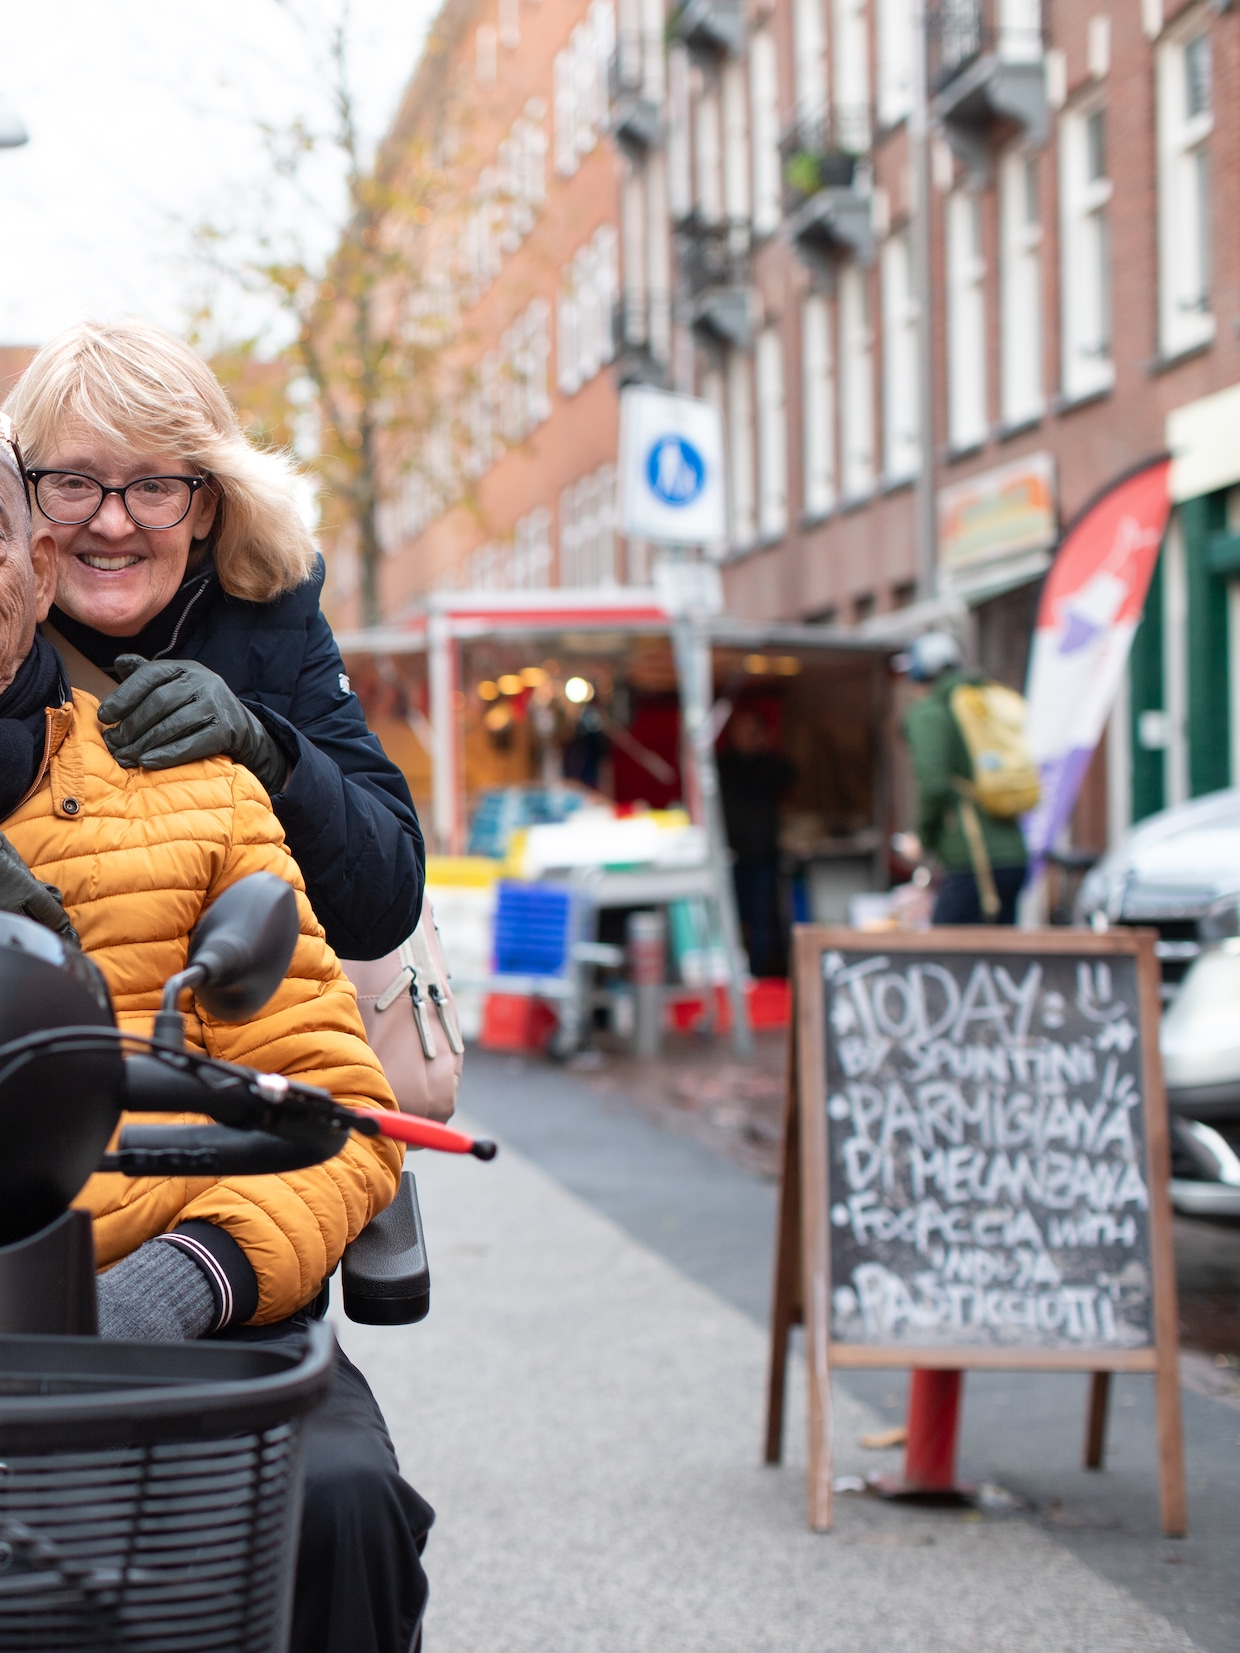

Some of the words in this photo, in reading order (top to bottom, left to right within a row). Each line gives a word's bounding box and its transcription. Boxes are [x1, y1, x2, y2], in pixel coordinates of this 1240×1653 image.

[832, 955, 1064, 1044] TODAY:
[838, 1035, 891, 1077] BY
[847, 1080, 1137, 1160] PARMIGIANA
[843, 1137, 896, 1192] DI
